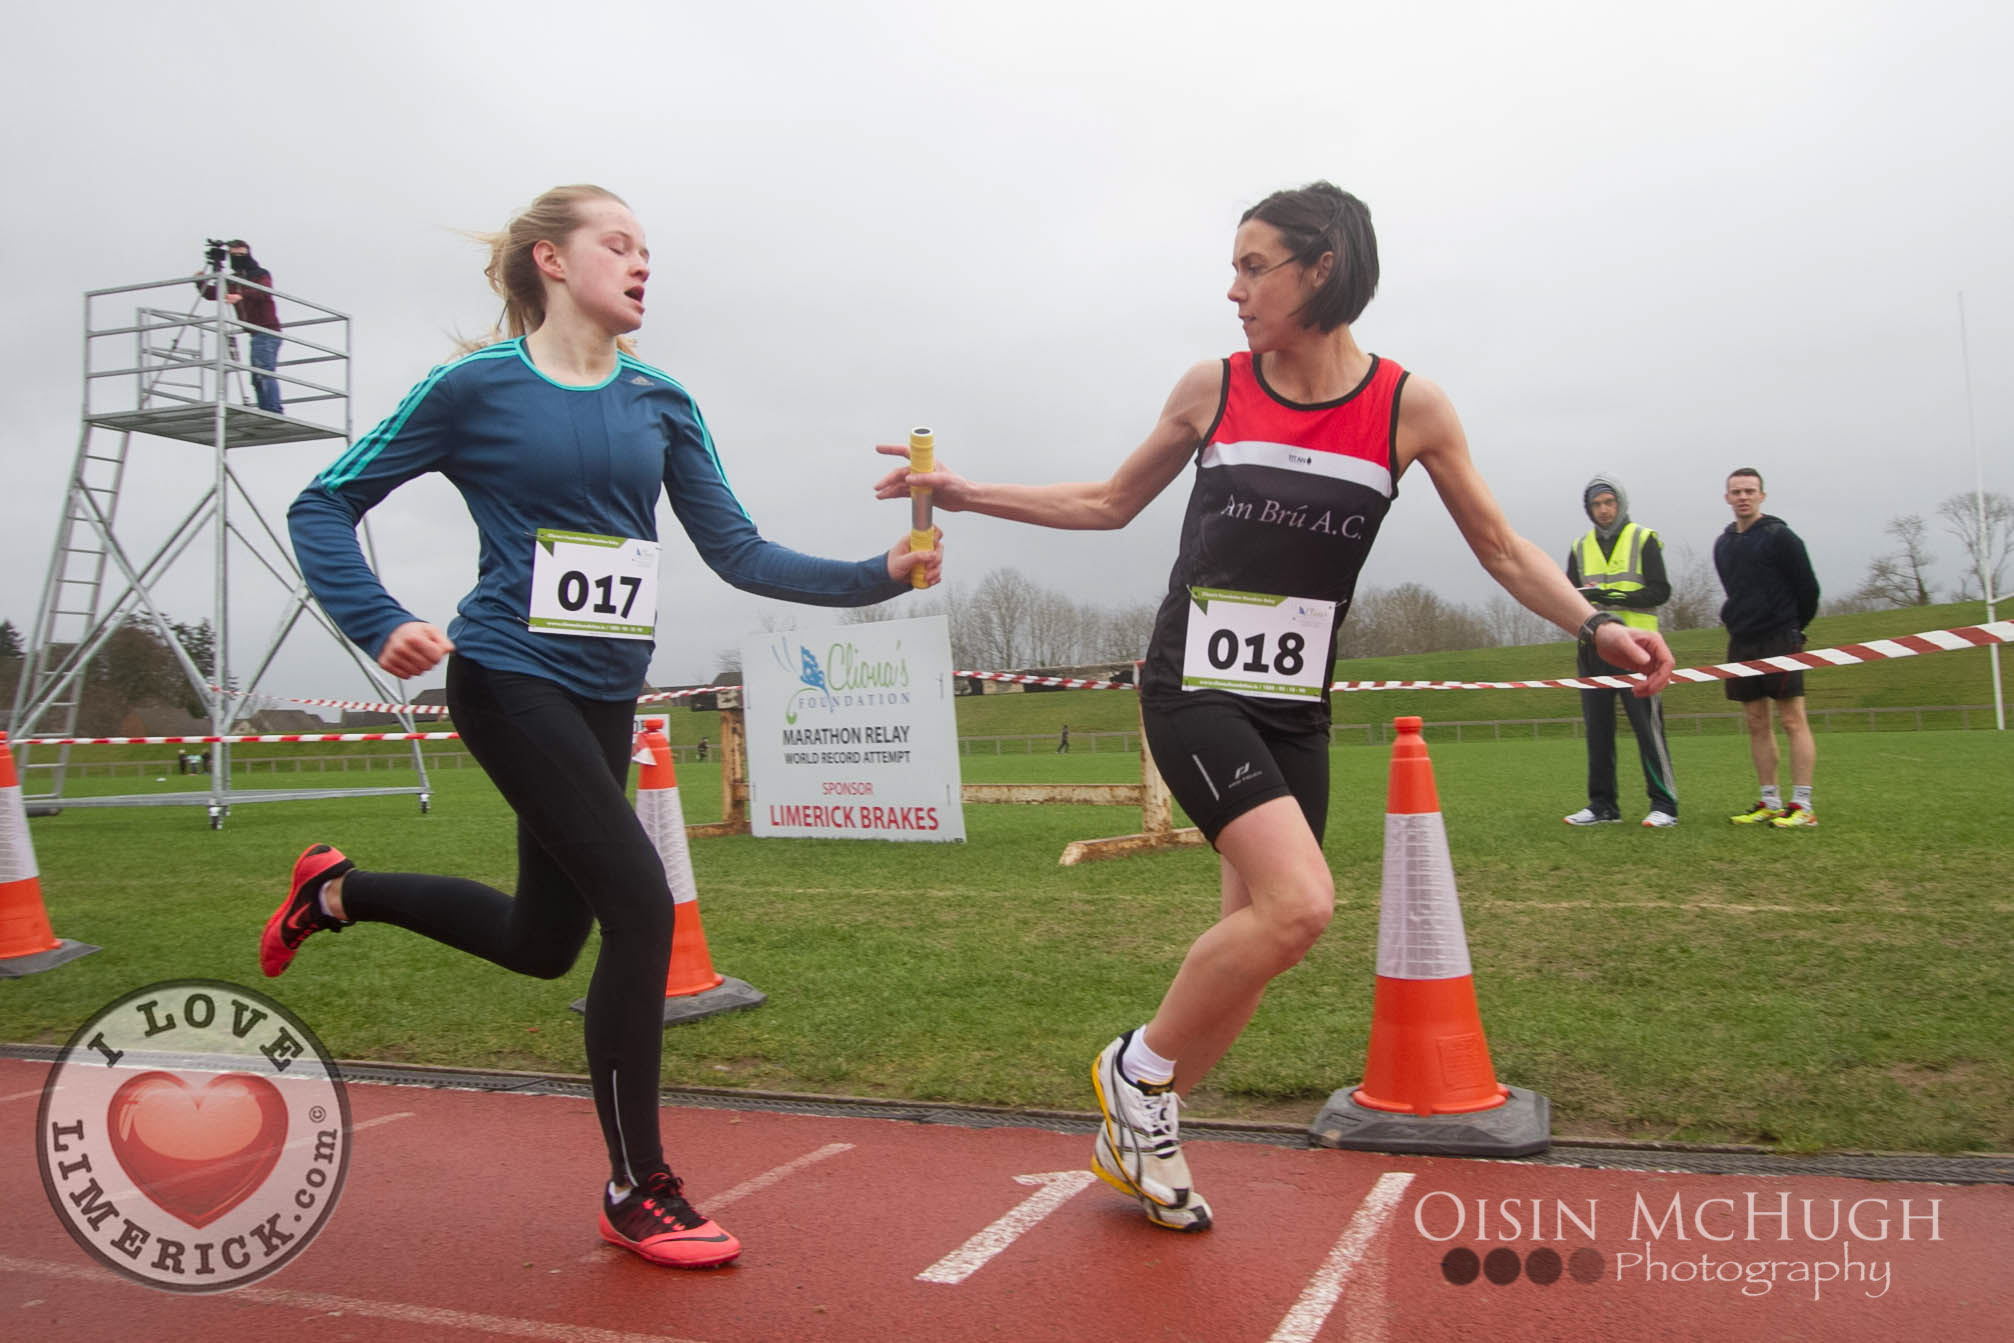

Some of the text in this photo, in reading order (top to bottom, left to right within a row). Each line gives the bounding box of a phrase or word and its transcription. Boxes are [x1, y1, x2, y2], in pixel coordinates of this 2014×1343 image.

[1220, 493, 1365, 540] An Brú A.C.
[557, 570, 642, 619] 017
[1207, 628, 1305, 676] 018
[827, 640, 910, 692] Cliona's
[798, 692, 911, 709] FOUNDATION
[783, 725, 910, 745] MARATHON RELAY
[784, 750, 911, 764] WORLD RECORD ATTEMPT
[822, 782, 873, 796] SPONSOR
[770, 804, 939, 831] LIMERICK BRAKES
